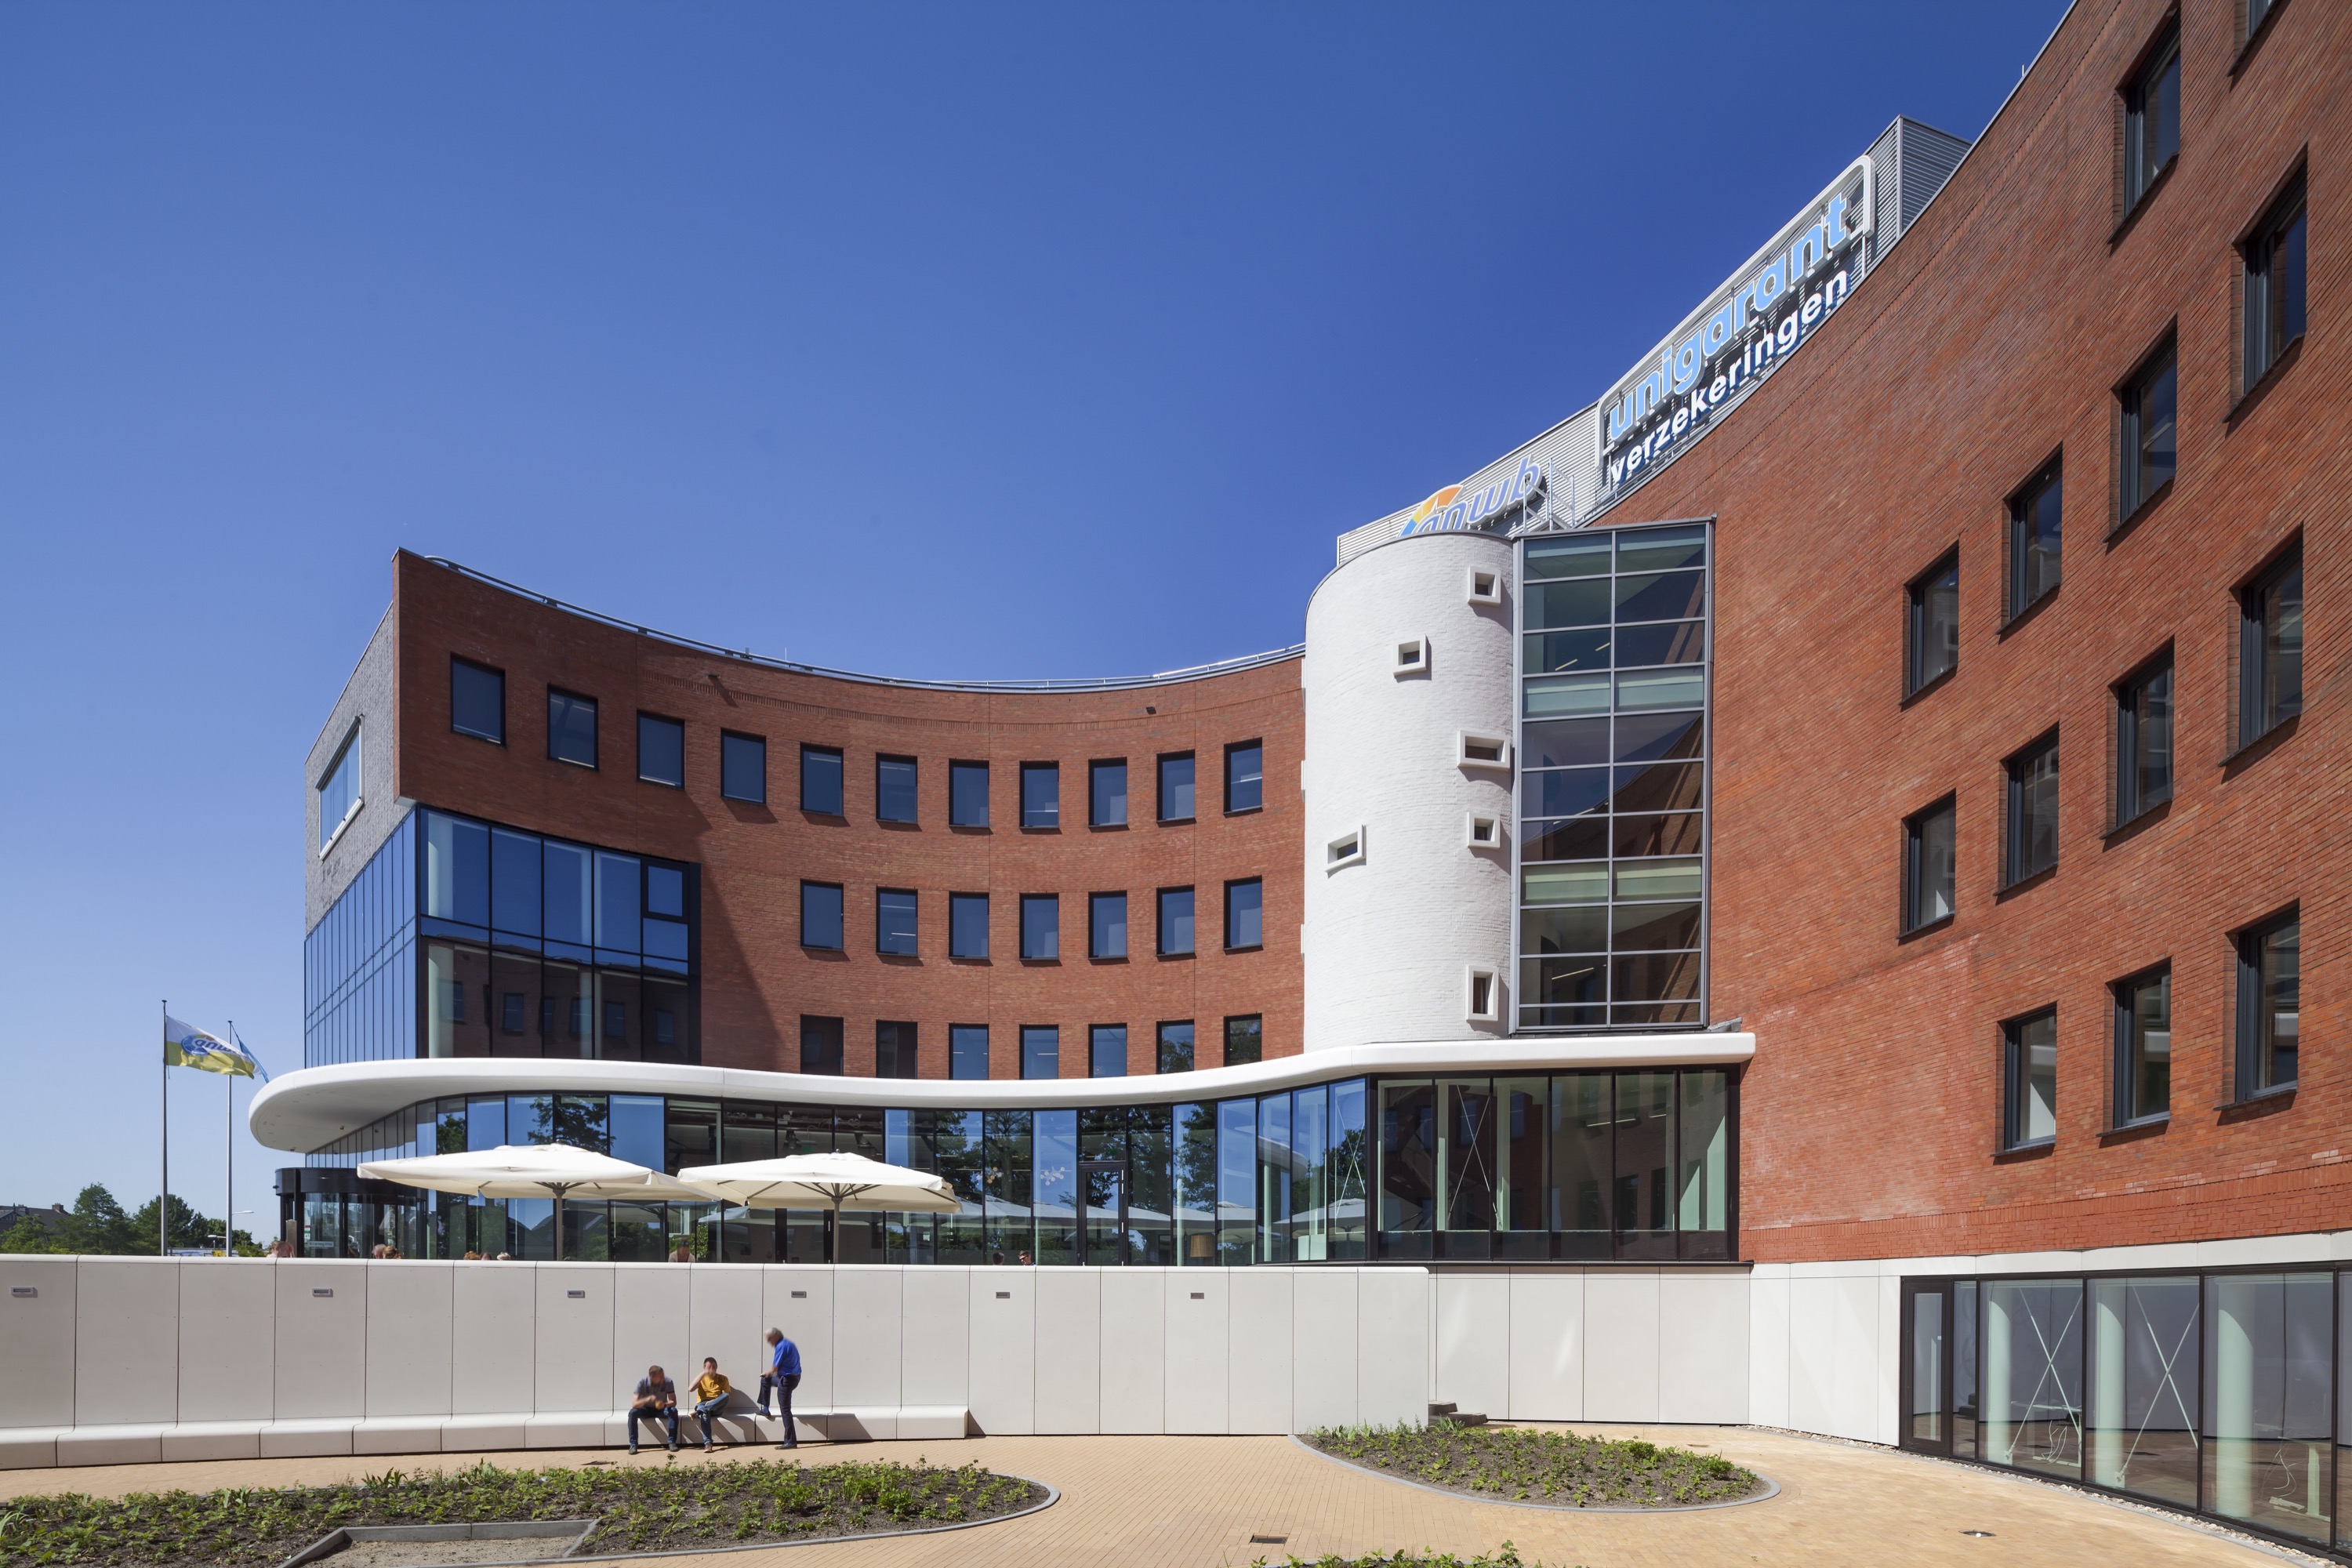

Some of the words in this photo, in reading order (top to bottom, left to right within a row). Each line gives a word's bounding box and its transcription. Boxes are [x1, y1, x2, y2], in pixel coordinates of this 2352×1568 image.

[1610, 193, 1848, 441] unigarant
[1610, 270, 1849, 484] verzekeringen
[194, 1039, 234, 1052] anw
